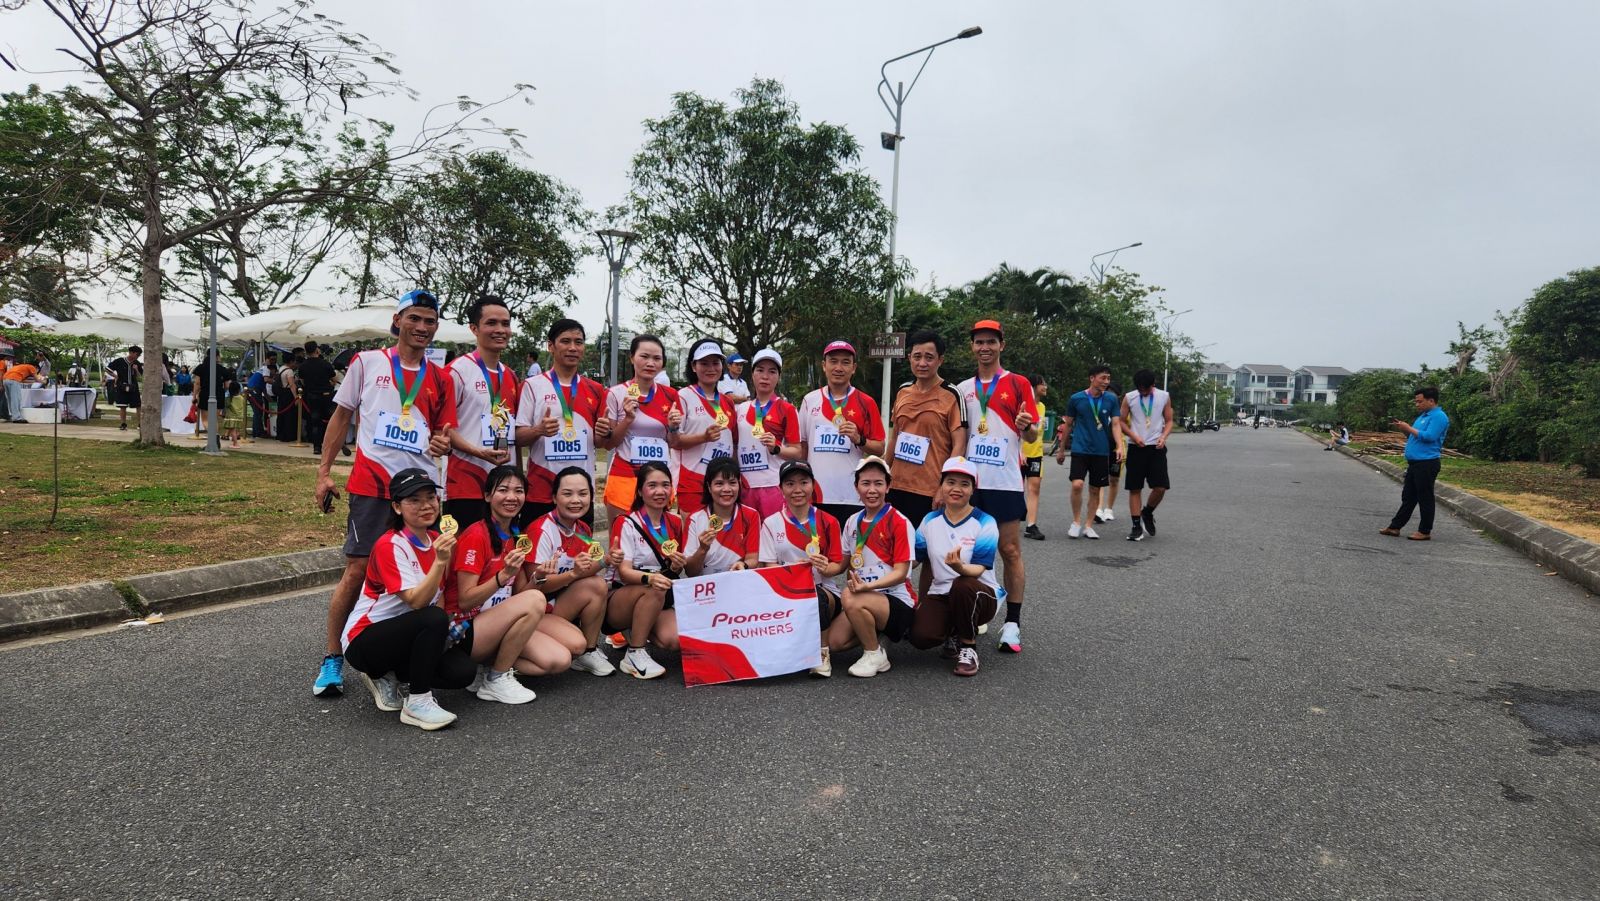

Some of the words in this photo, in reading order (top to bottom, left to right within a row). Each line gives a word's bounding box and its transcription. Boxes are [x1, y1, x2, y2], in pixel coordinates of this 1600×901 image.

[375, 376, 391, 384] PR
[475, 381, 487, 390] PR
[544, 393, 557, 402] PR
[385, 424, 418, 444] 1090
[820, 434, 846, 446] 1076
[552, 440, 581, 453] 1085
[638, 446, 663, 458] 1089
[899, 442, 921, 457] 1066
[975, 444, 1000, 458] 1088
[740, 452, 762, 465] 1082
[694, 581, 716, 598] PR
[711, 609, 794, 628] Pioneer
[731, 623, 794, 640] RUNNERS
